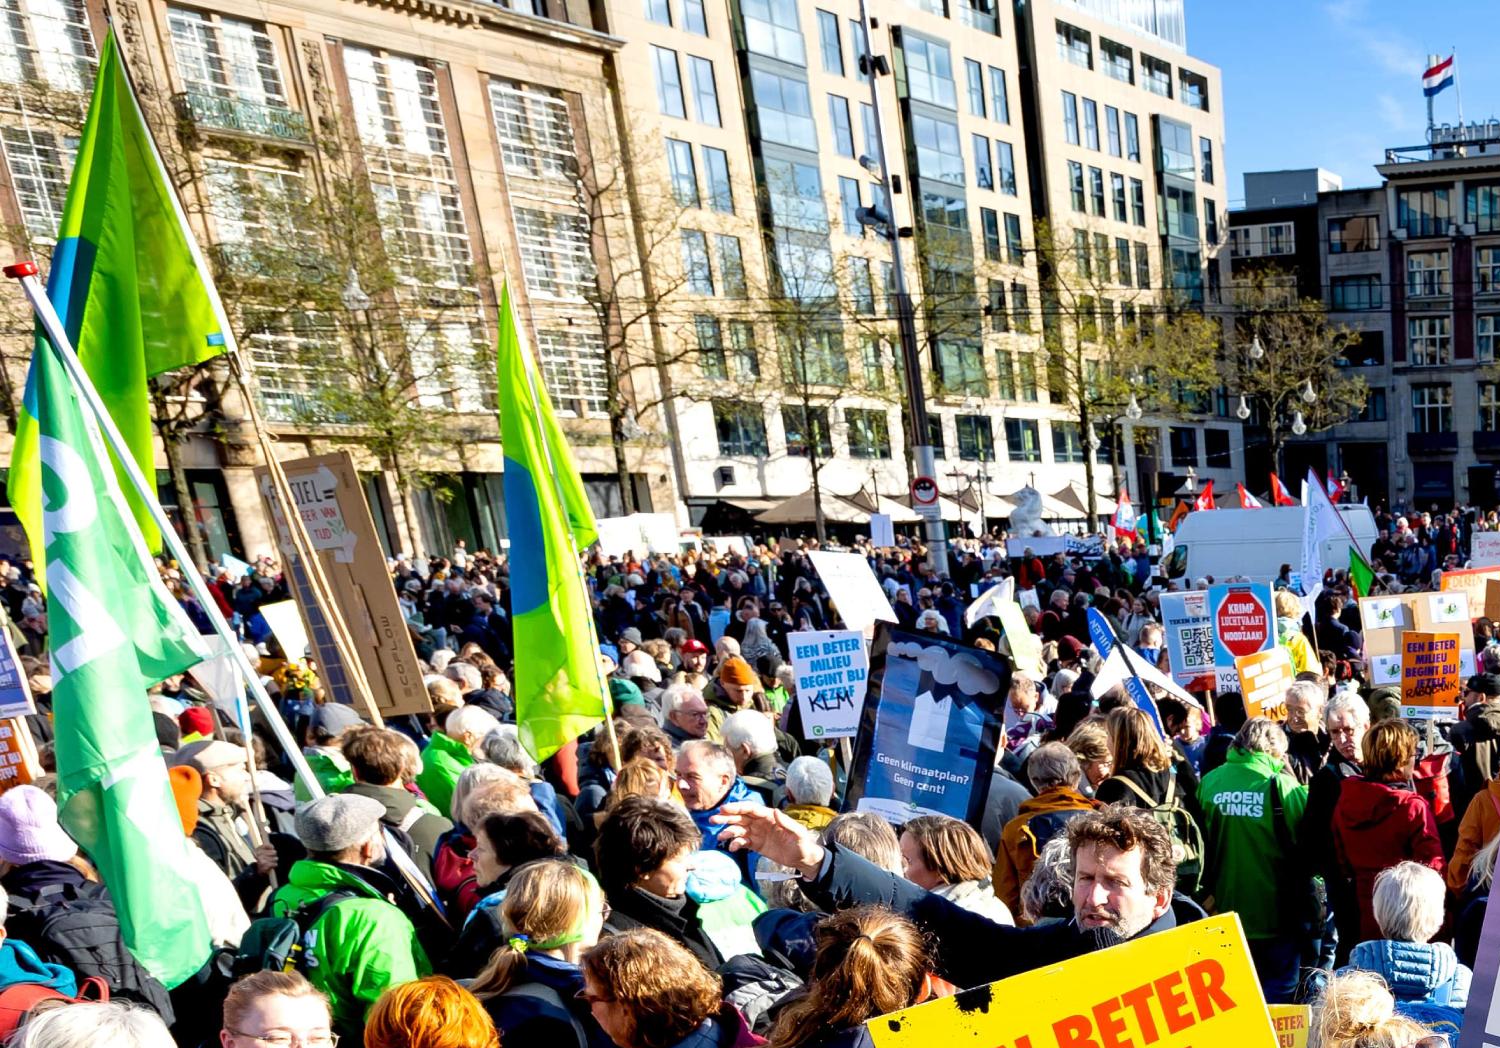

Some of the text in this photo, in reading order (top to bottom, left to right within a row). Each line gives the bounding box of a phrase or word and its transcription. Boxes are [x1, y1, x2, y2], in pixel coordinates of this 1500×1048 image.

[320, 507, 337, 519] VAN
[1228, 603, 1254, 614] KRIMP
[1221, 616, 1264, 626] LUCHTVAART
[796, 639, 860, 659] EEN BETER
[1407, 640, 1456, 653] EEN BETER
[810, 655, 851, 673] MILIEU
[1415, 653, 1447, 664] MILIEU
[1405, 664, 1456, 677] BEGINT BIJ
[800, 668, 866, 689] BEGINT BIJ
[808, 690, 854, 712] KLM
[877, 753, 969, 785] Geen klimaatplan?
[894, 773, 945, 795] Geen cent!
[1213, 791, 1264, 805] GROEN
[1219, 803, 1263, 818] LINKS
